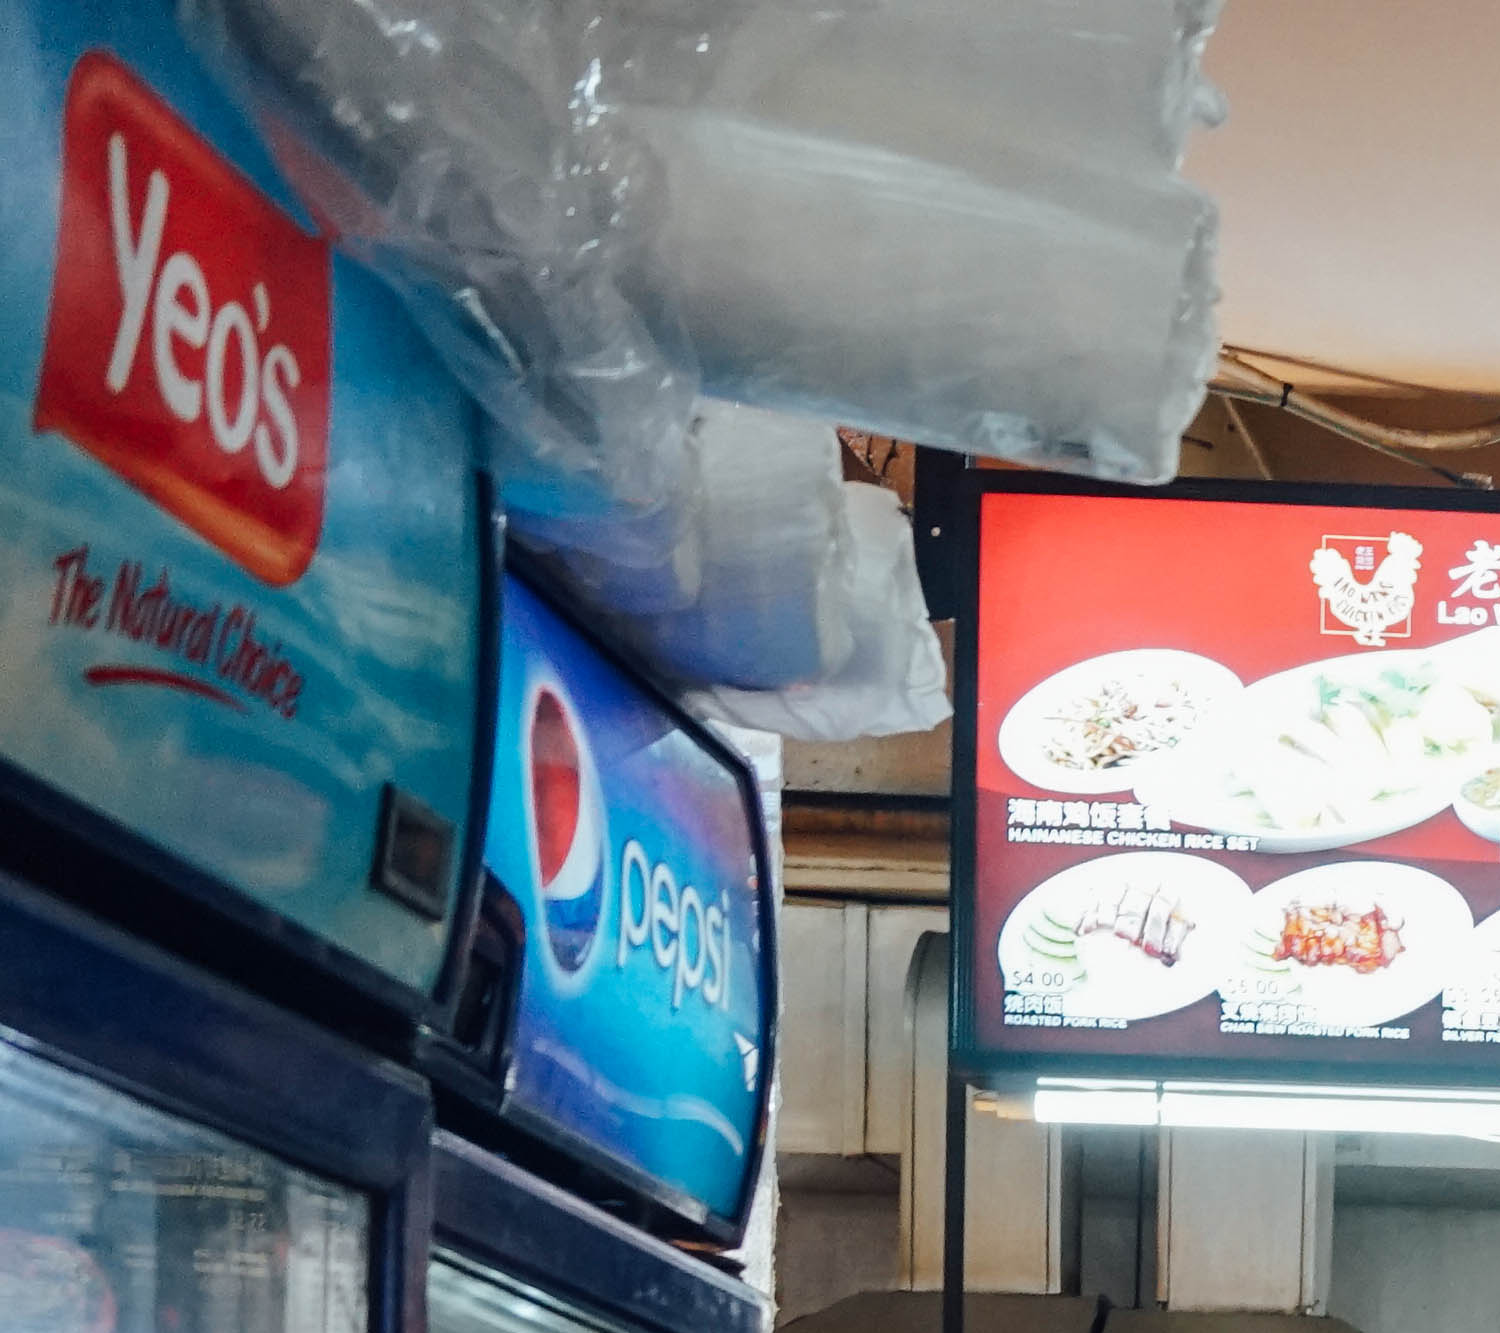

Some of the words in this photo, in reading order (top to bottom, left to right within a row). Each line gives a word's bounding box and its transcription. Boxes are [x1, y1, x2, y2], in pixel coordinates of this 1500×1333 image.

[107, 132, 302, 490] Yeo's
[50, 547, 107, 625] The
[106, 563, 219, 670] Natural
[216, 600, 306, 720] Choice
[1437, 600, 1487, 627] Lao
[1008, 828, 1104, 847] HAINANESE
[1107, 831, 1181, 849] CHICKEN
[1184, 833, 1223, 850] RICE
[1226, 835, 1261, 852] SET
[617, 838, 732, 1016] pepsi
